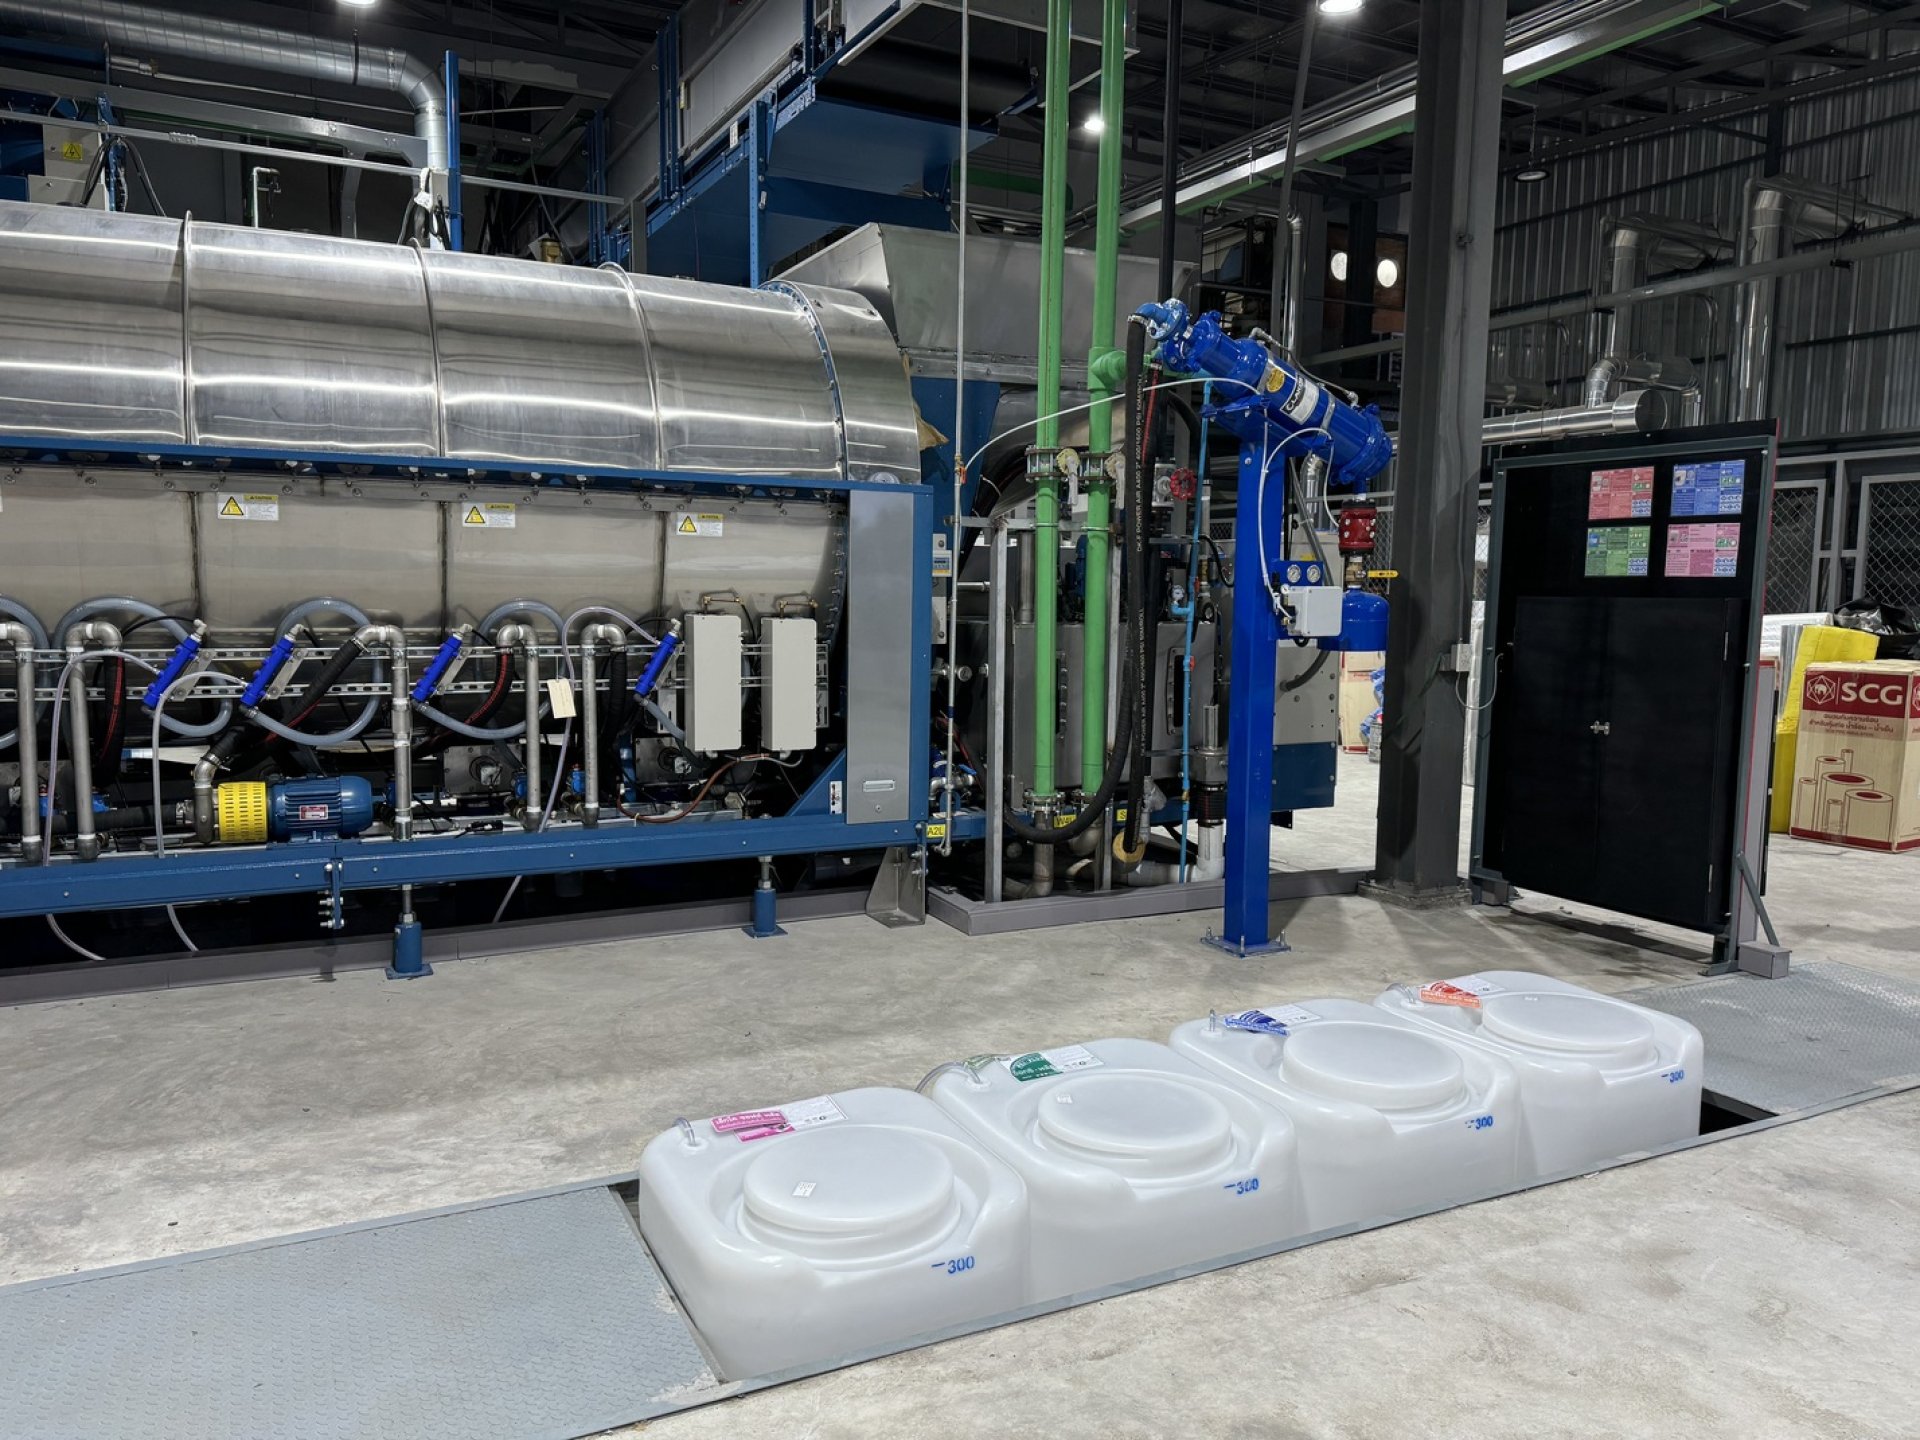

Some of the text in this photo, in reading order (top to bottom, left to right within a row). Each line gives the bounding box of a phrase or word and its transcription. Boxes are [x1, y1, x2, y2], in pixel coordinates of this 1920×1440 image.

[1841, 682, 1903, 706] SCG
[1476, 1116, 1493, 1130] 300
[1236, 1178, 1259, 1194] 300
[948, 1256, 975, 1274] 300
